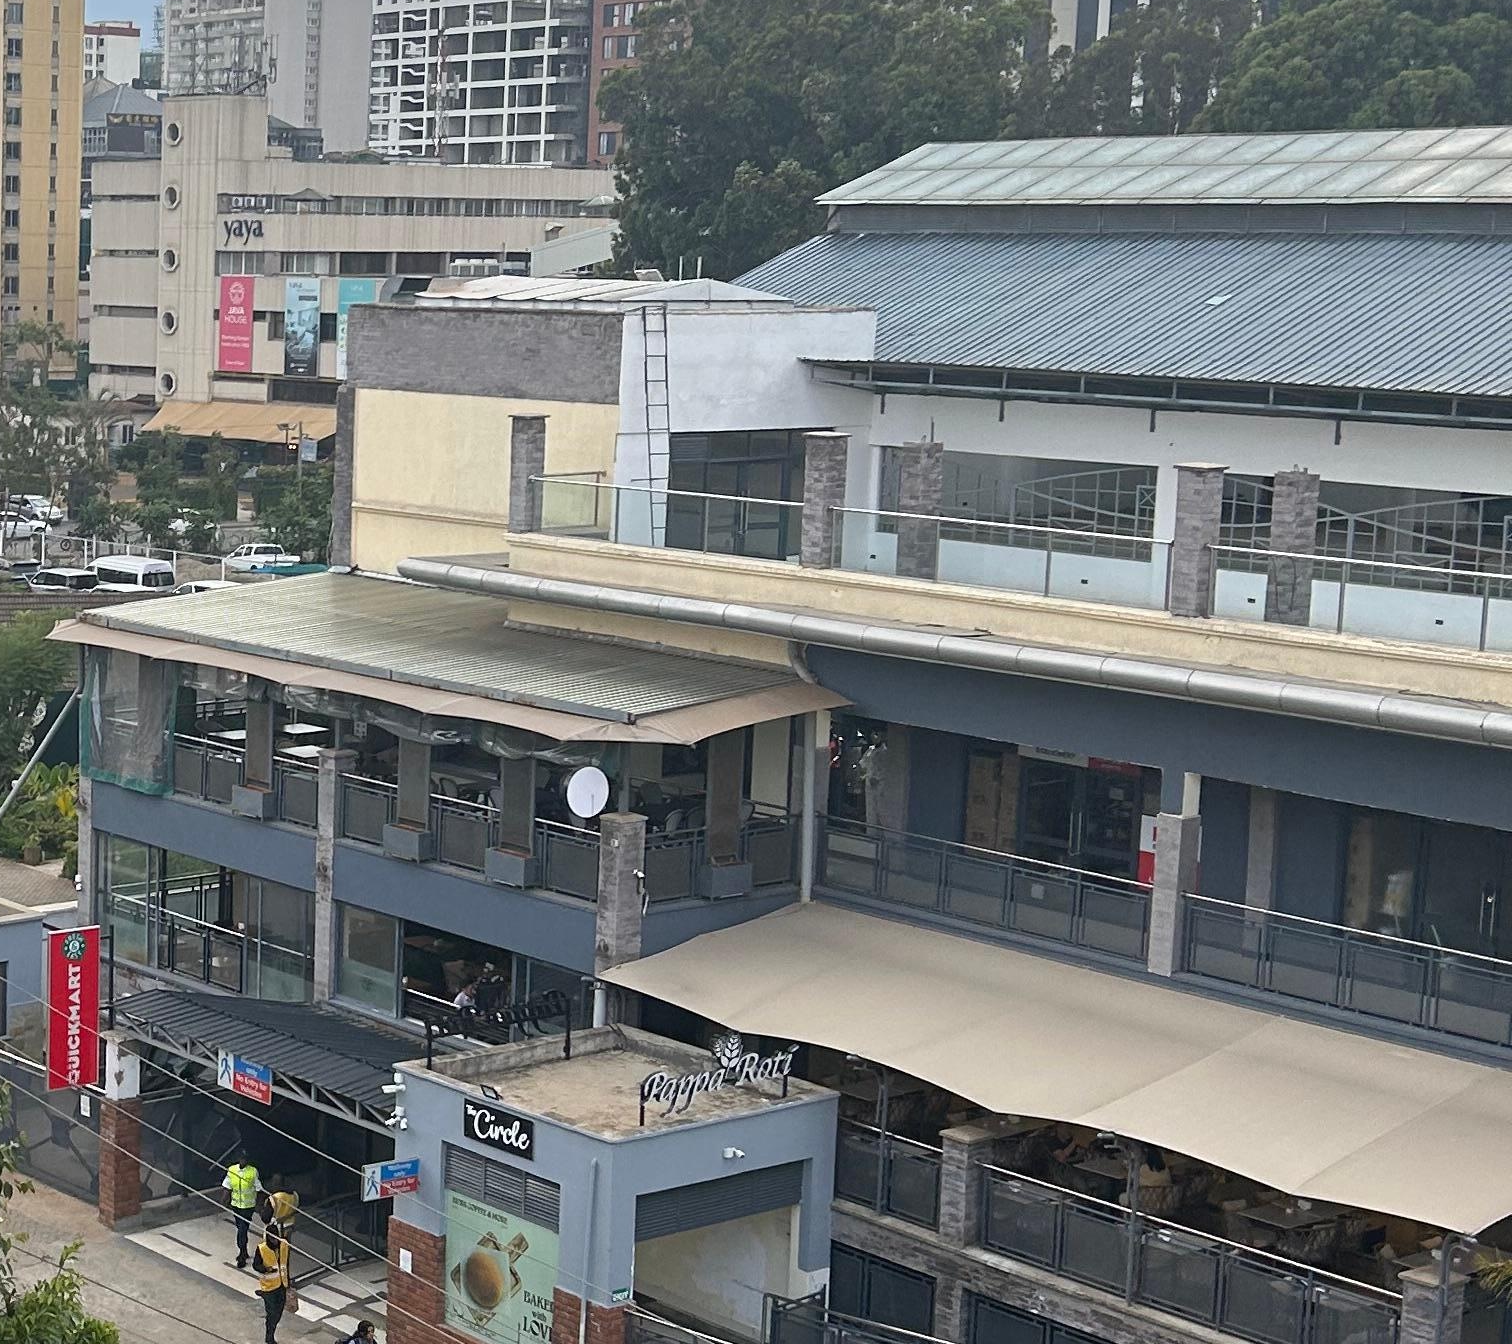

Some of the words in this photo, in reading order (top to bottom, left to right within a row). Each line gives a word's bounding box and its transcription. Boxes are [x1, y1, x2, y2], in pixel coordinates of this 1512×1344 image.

[224, 219, 264, 246] yaya
[224, 316, 248, 324] HOUSE
[643, 1070, 726, 1119] Pappa
[473, 1109, 530, 1150] Circle
